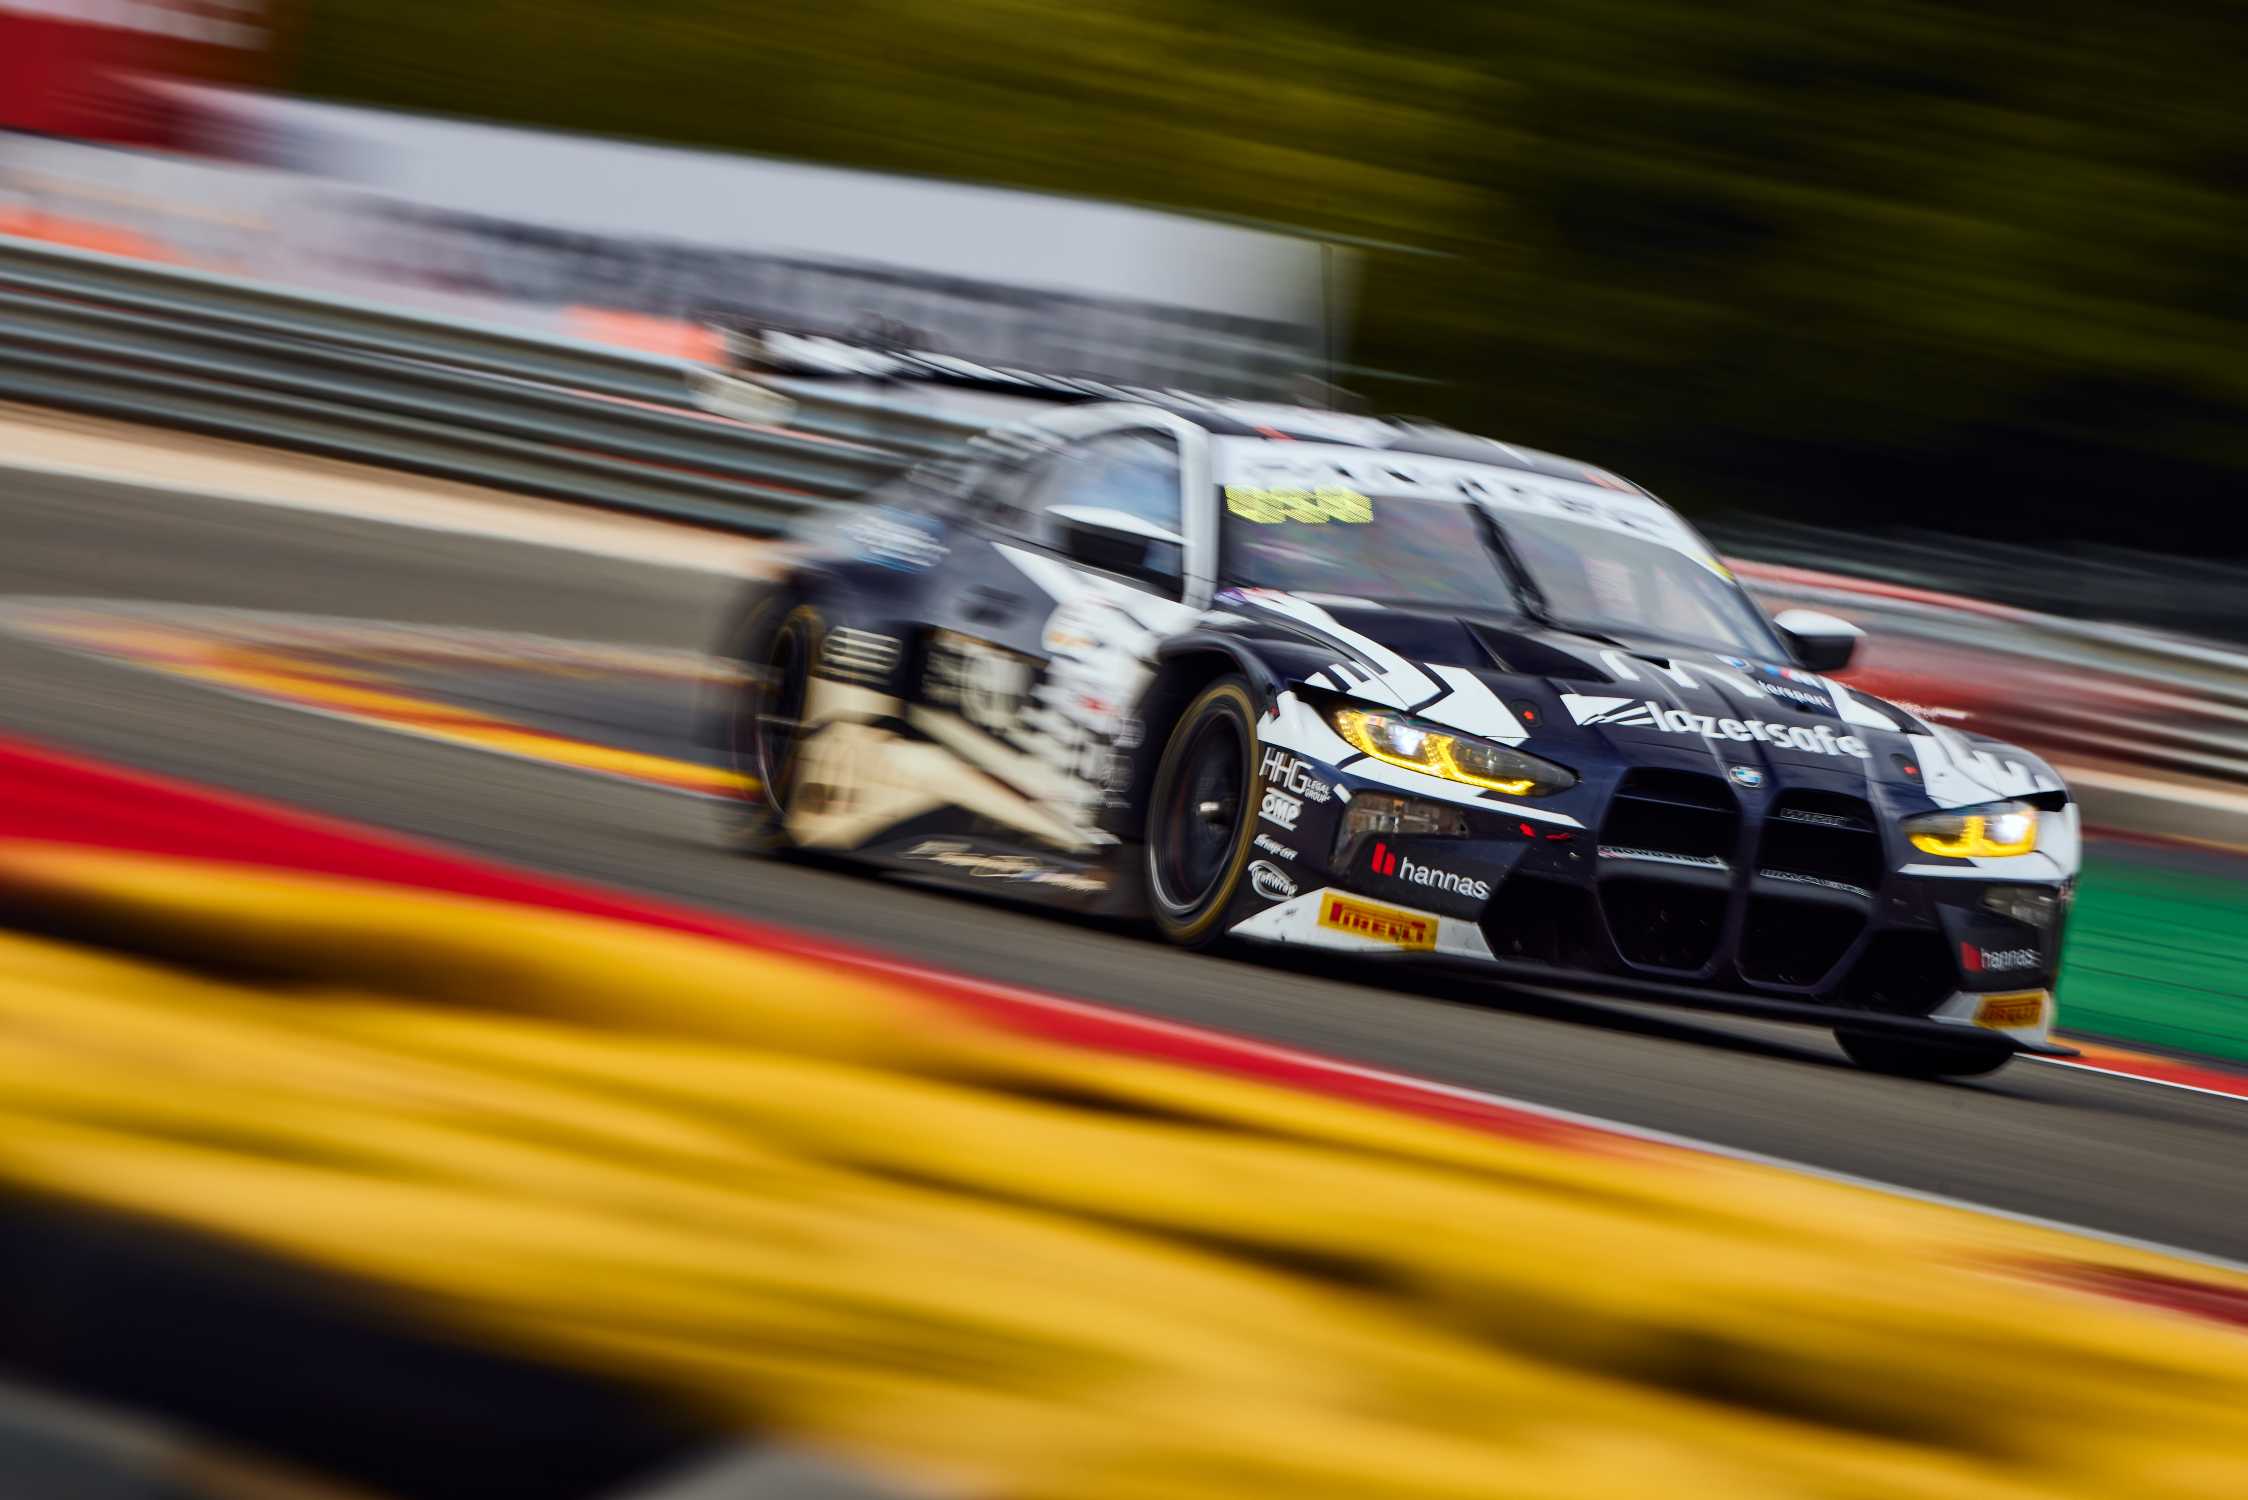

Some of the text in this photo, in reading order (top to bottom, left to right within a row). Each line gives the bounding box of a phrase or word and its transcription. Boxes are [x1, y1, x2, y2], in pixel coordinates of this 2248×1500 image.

[1645, 701, 1872, 758] lazersafe
[1259, 747, 1313, 794] HHG
[1261, 792, 1301, 825] OMP
[1400, 856, 1492, 900] hannas
[1329, 902, 1426, 943] PIRELLI
[1980, 948, 2041, 971] hannas
